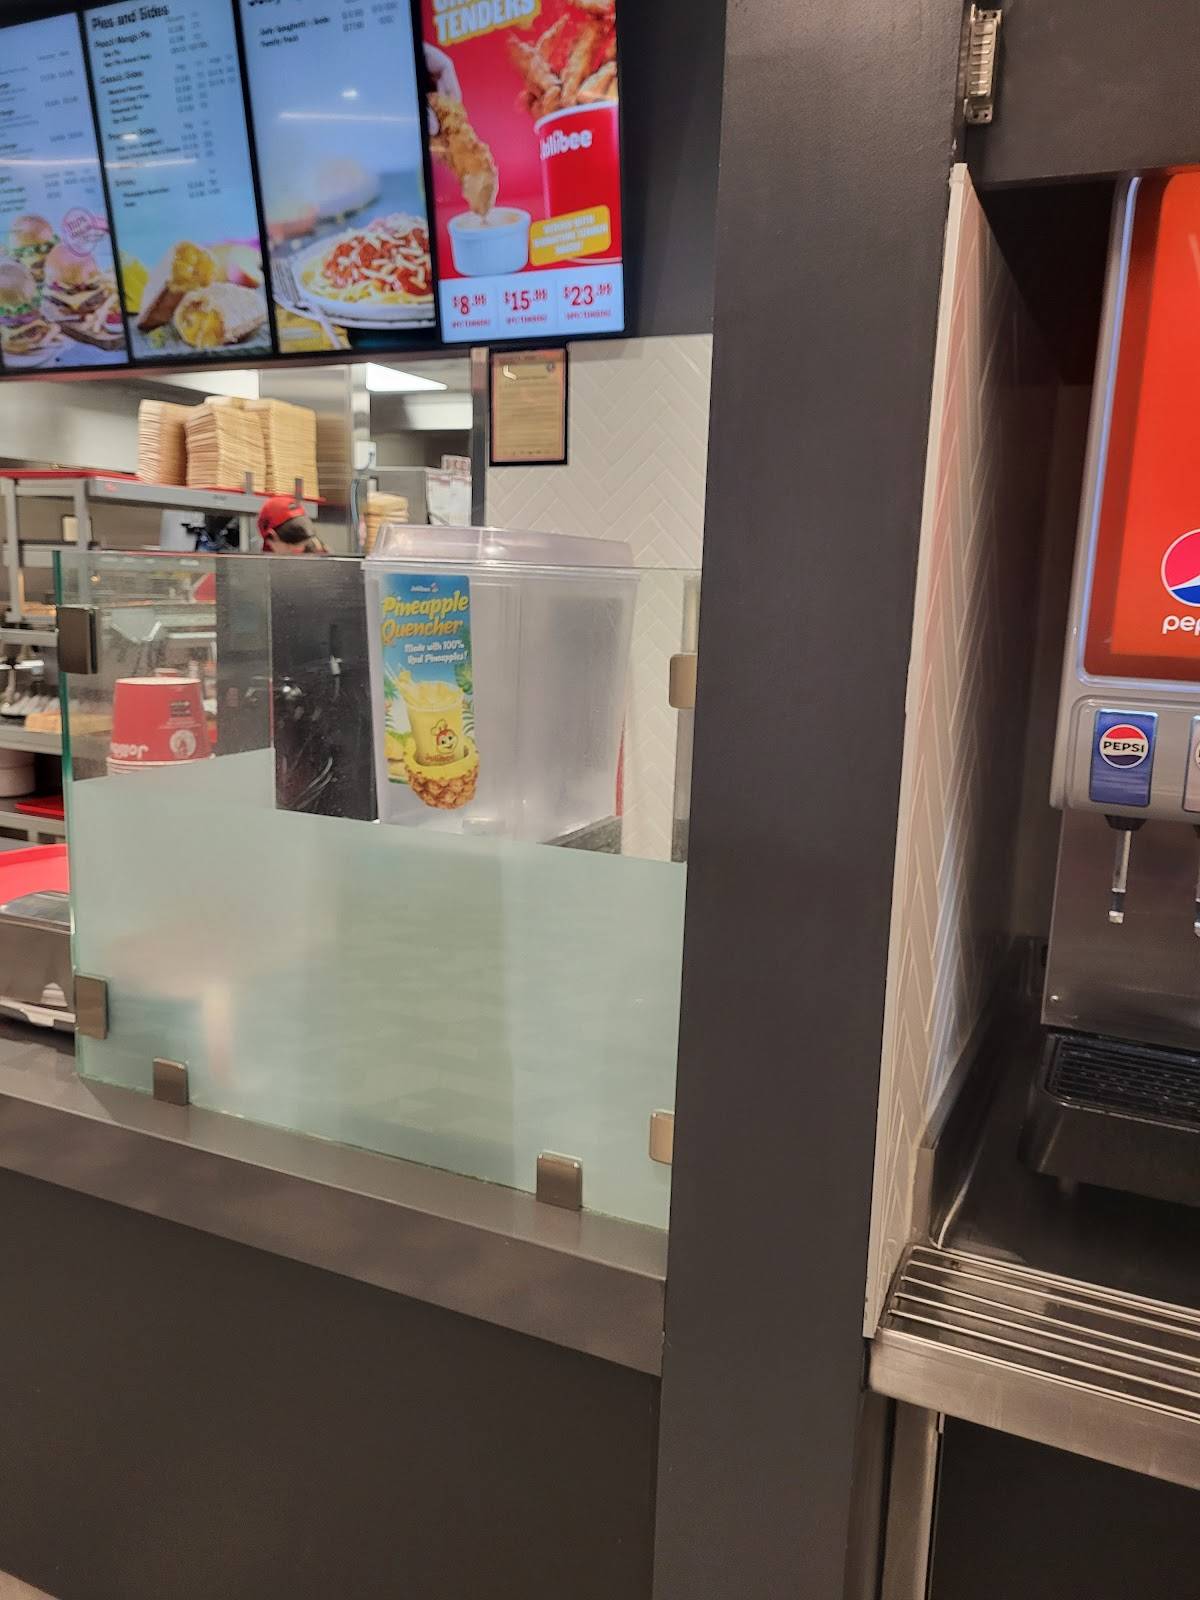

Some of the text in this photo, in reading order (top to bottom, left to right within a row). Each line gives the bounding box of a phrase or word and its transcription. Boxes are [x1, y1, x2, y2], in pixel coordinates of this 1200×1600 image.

[436, 0, 535, 45] TENDERS
[383, 590, 469, 620] Pineapple
[383, 617, 464, 646] Quencher
[404, 639, 465, 653] Made with 100%
[408, 654, 424, 664] Real
[1103, 740, 1146, 753] PEPSI
